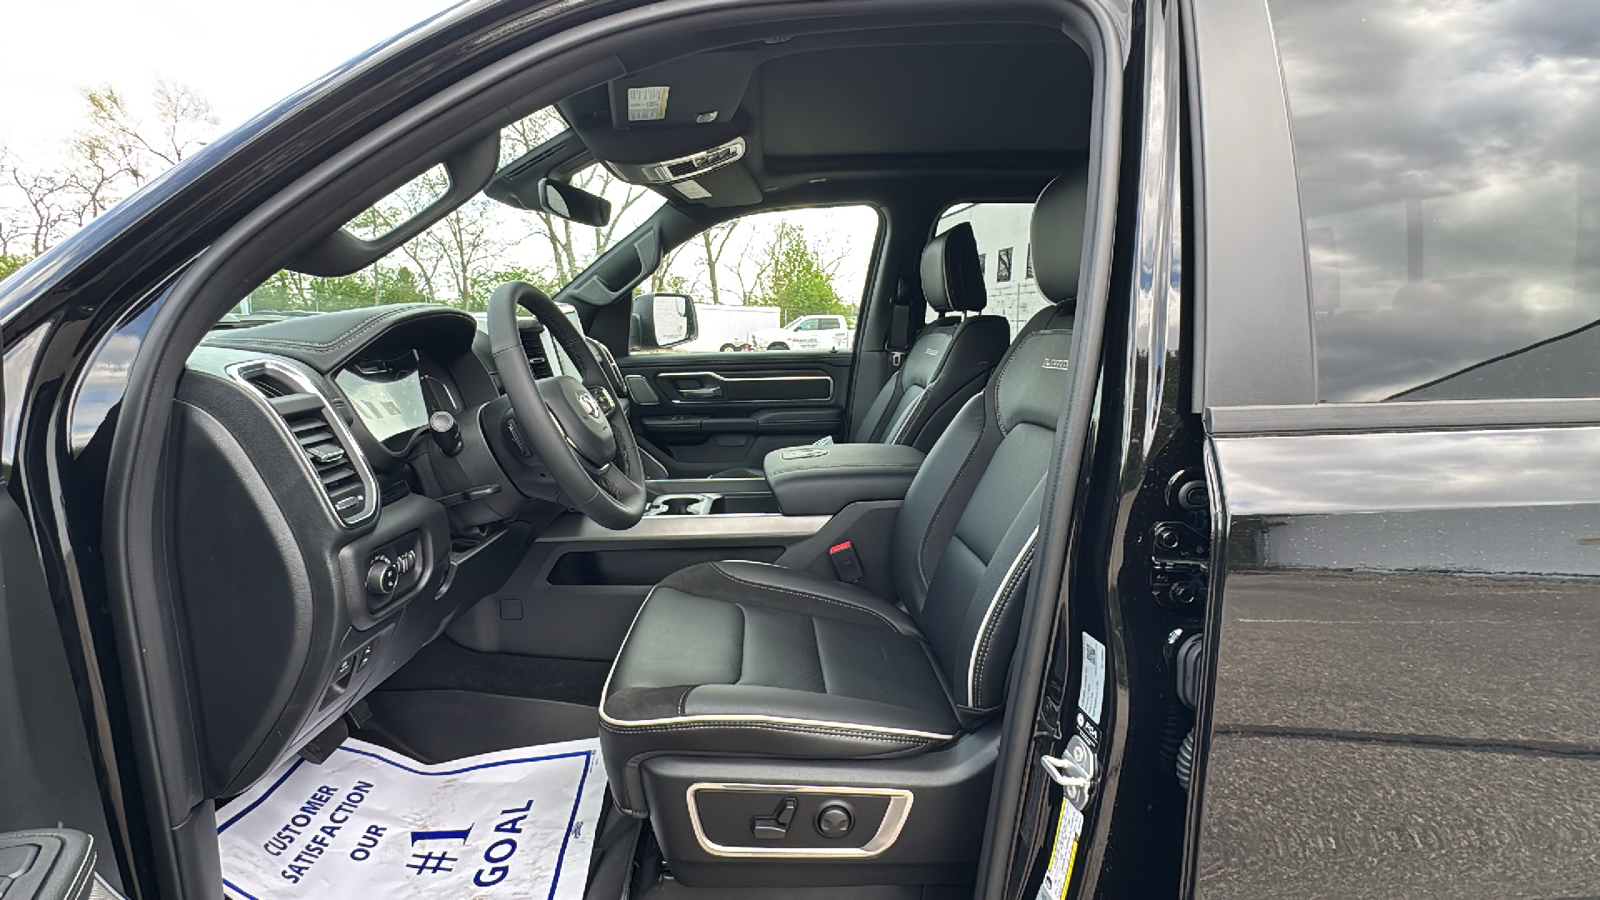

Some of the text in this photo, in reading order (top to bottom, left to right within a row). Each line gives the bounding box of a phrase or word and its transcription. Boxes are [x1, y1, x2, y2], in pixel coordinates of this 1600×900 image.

[263, 785, 338, 857] CUSTOMER
[281, 780, 374, 884] SATISFACTION
[350, 824, 388, 862] OUR
[405, 822, 475, 876] #1
[473, 799, 534, 888] GOAL
